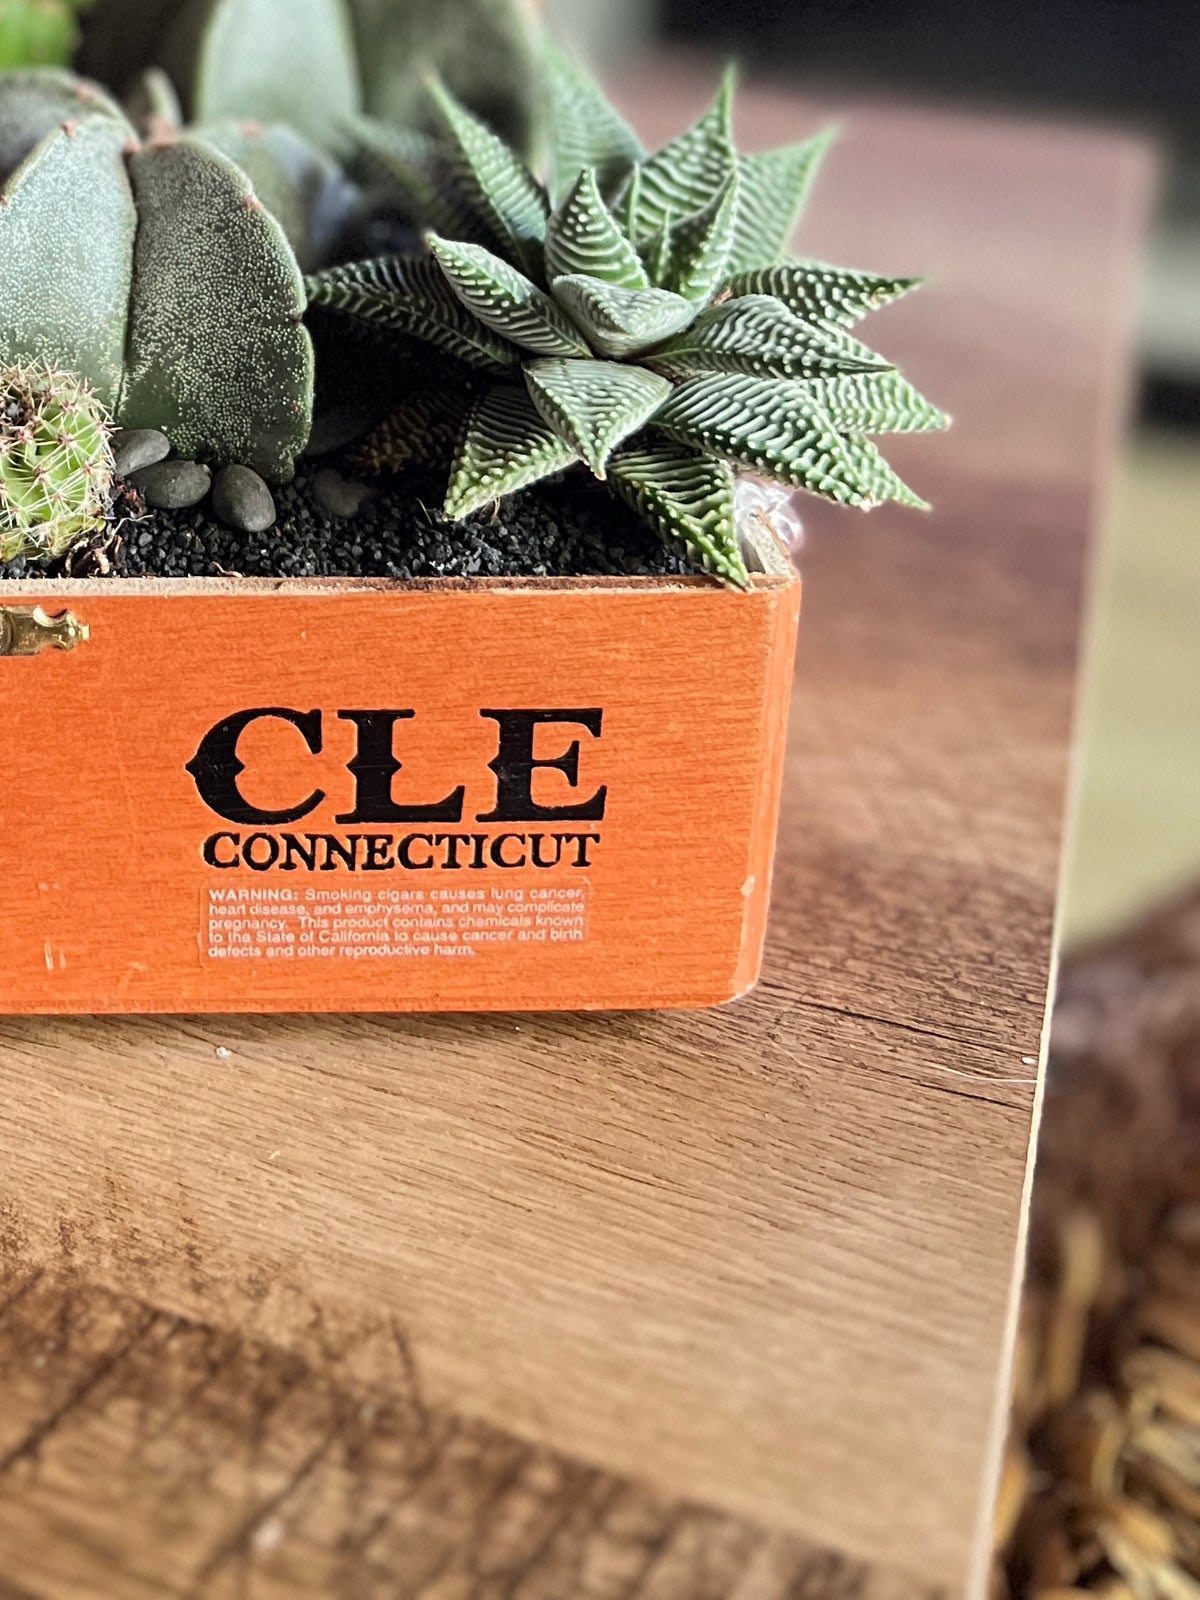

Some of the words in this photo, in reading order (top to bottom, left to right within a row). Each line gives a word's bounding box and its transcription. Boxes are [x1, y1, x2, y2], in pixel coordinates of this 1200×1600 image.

[185, 707, 607, 825] CLE
[203, 832, 600, 871] CONNECTICUT
[209, 888, 299, 901] WARNING:
[305, 888, 372, 903] Smoking
[377, 888, 424, 902] cigars
[430, 889, 485, 900] causes
[491, 887, 524, 901] lung
[529, 888, 585, 900] cancer,
[209, 903, 246, 915] heart
[250, 903, 310, 917] disease,
[313, 903, 341, 915] and
[344, 903, 438, 918] emphysema,
[442, 901, 469, 913] and
[472, 903, 504, 916] may
[507, 901, 585, 916] complicate
[209, 918, 289, 931] pregnancy.
[298, 916, 329, 929] This
[333, 917, 388, 930] product
[392, 916, 454, 928] contains
[458, 915, 532, 927] chemicals
[535, 914, 584, 926] known
[209, 931, 223, 943] to
[228, 931, 251, 943] the
[256, 930, 295, 943] State
[299, 930, 314, 943] of
[318, 930, 390, 943] California
[394, 931, 409, 942] to
[412, 932, 458, 942] cause
[462, 931, 514, 941] cancer
[517, 929, 546, 940] and
[550, 928, 583, 940] birth
[208, 945, 262, 957] defects
[266, 945, 294, 957] and
[298, 945, 336, 957] other
[339, 944, 430, 959] reproductive
[434, 943, 477, 955] harm.
